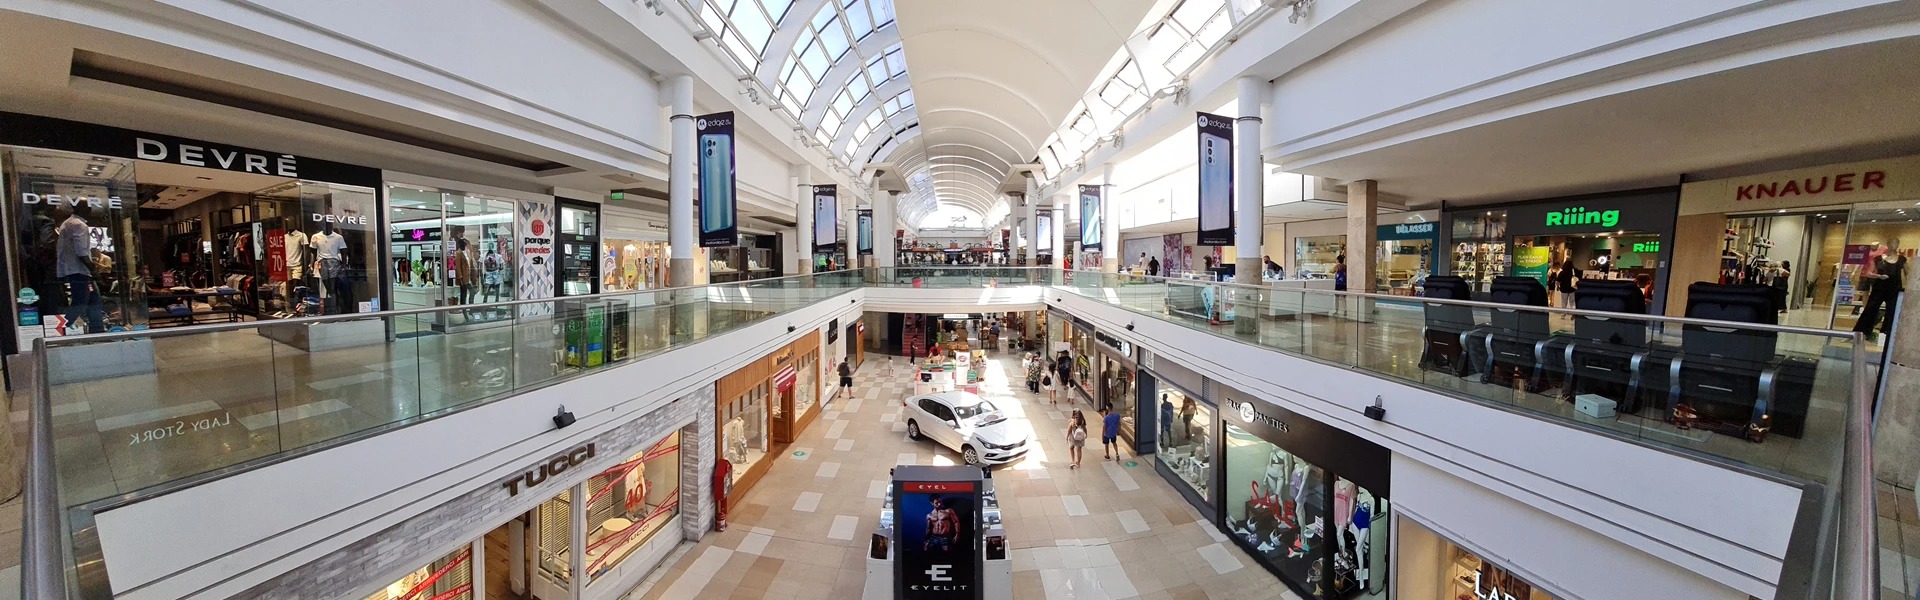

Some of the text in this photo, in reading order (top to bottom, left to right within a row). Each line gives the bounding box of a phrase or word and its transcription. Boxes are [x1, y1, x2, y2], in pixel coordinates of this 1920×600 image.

[708, 118, 725, 127] edge
[1208, 119, 1226, 129] edge
[1736, 171, 1885, 201] KNAUER
[1546, 206, 1620, 228] Riiing
[269, 236, 283, 248] SALE
[524, 237, 551, 245] porque
[524, 246, 551, 255] puedes
[272, 255, 283, 272] 70
[532, 256, 544, 265] sh
[502, 442, 595, 498] TUCCI
[1250, 480, 1297, 529] SALE
